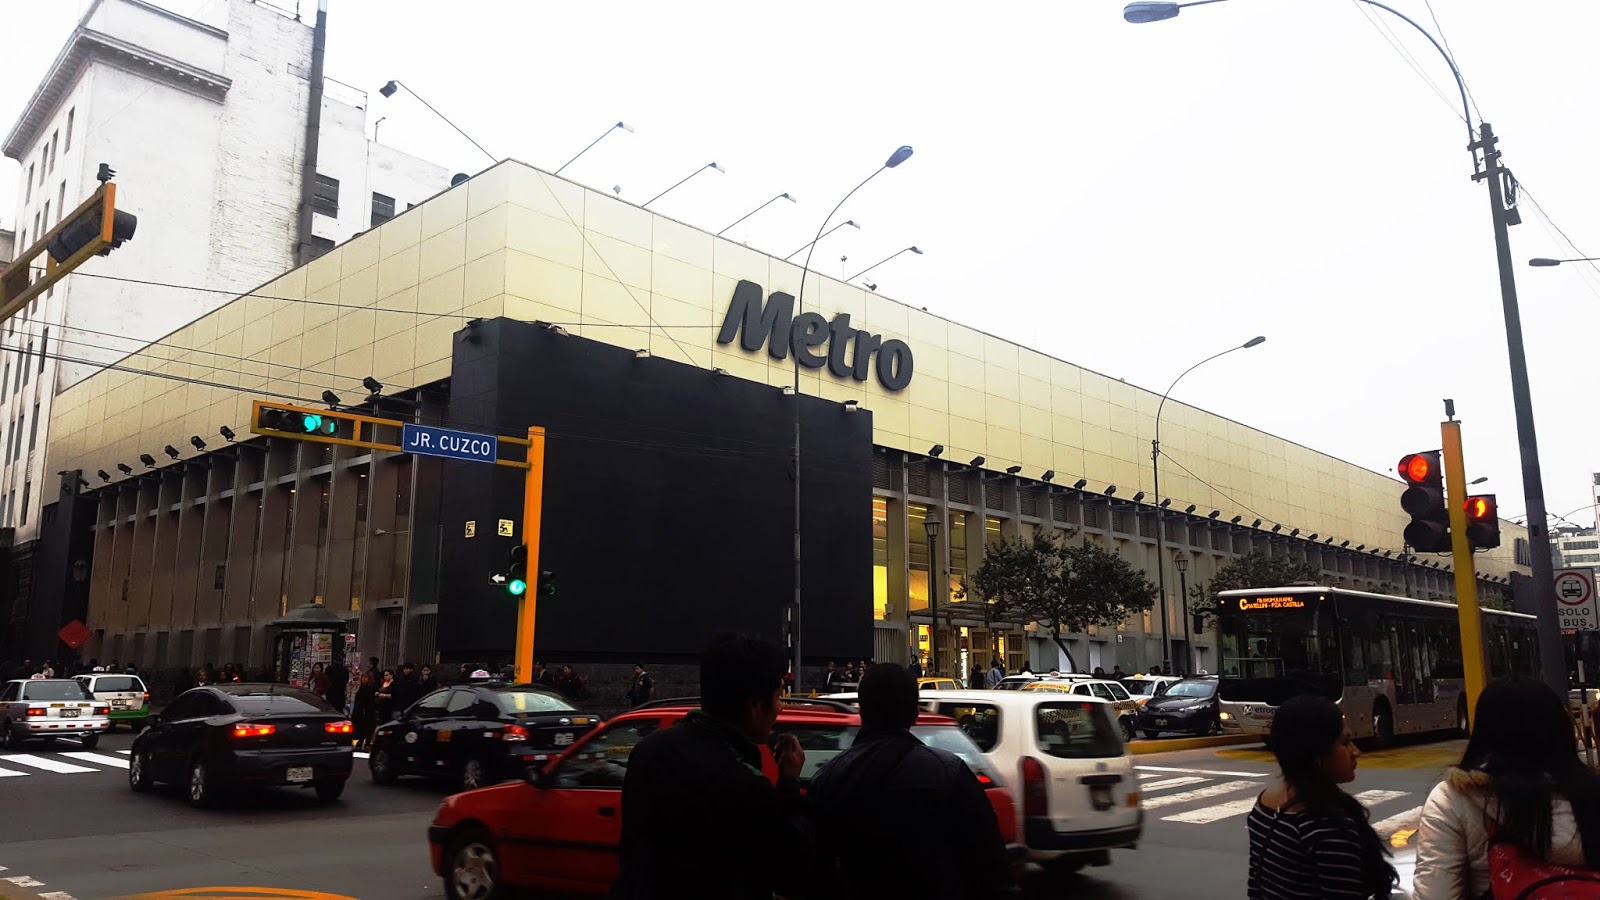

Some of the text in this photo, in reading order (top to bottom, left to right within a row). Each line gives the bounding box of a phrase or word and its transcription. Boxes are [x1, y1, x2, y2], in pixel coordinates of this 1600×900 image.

[717, 279, 914, 391] Metro
[410, 431, 491, 456] JR. CUZCO
[1558, 607, 1590, 616] SOLO
[1563, 618, 1587, 627] BUS
